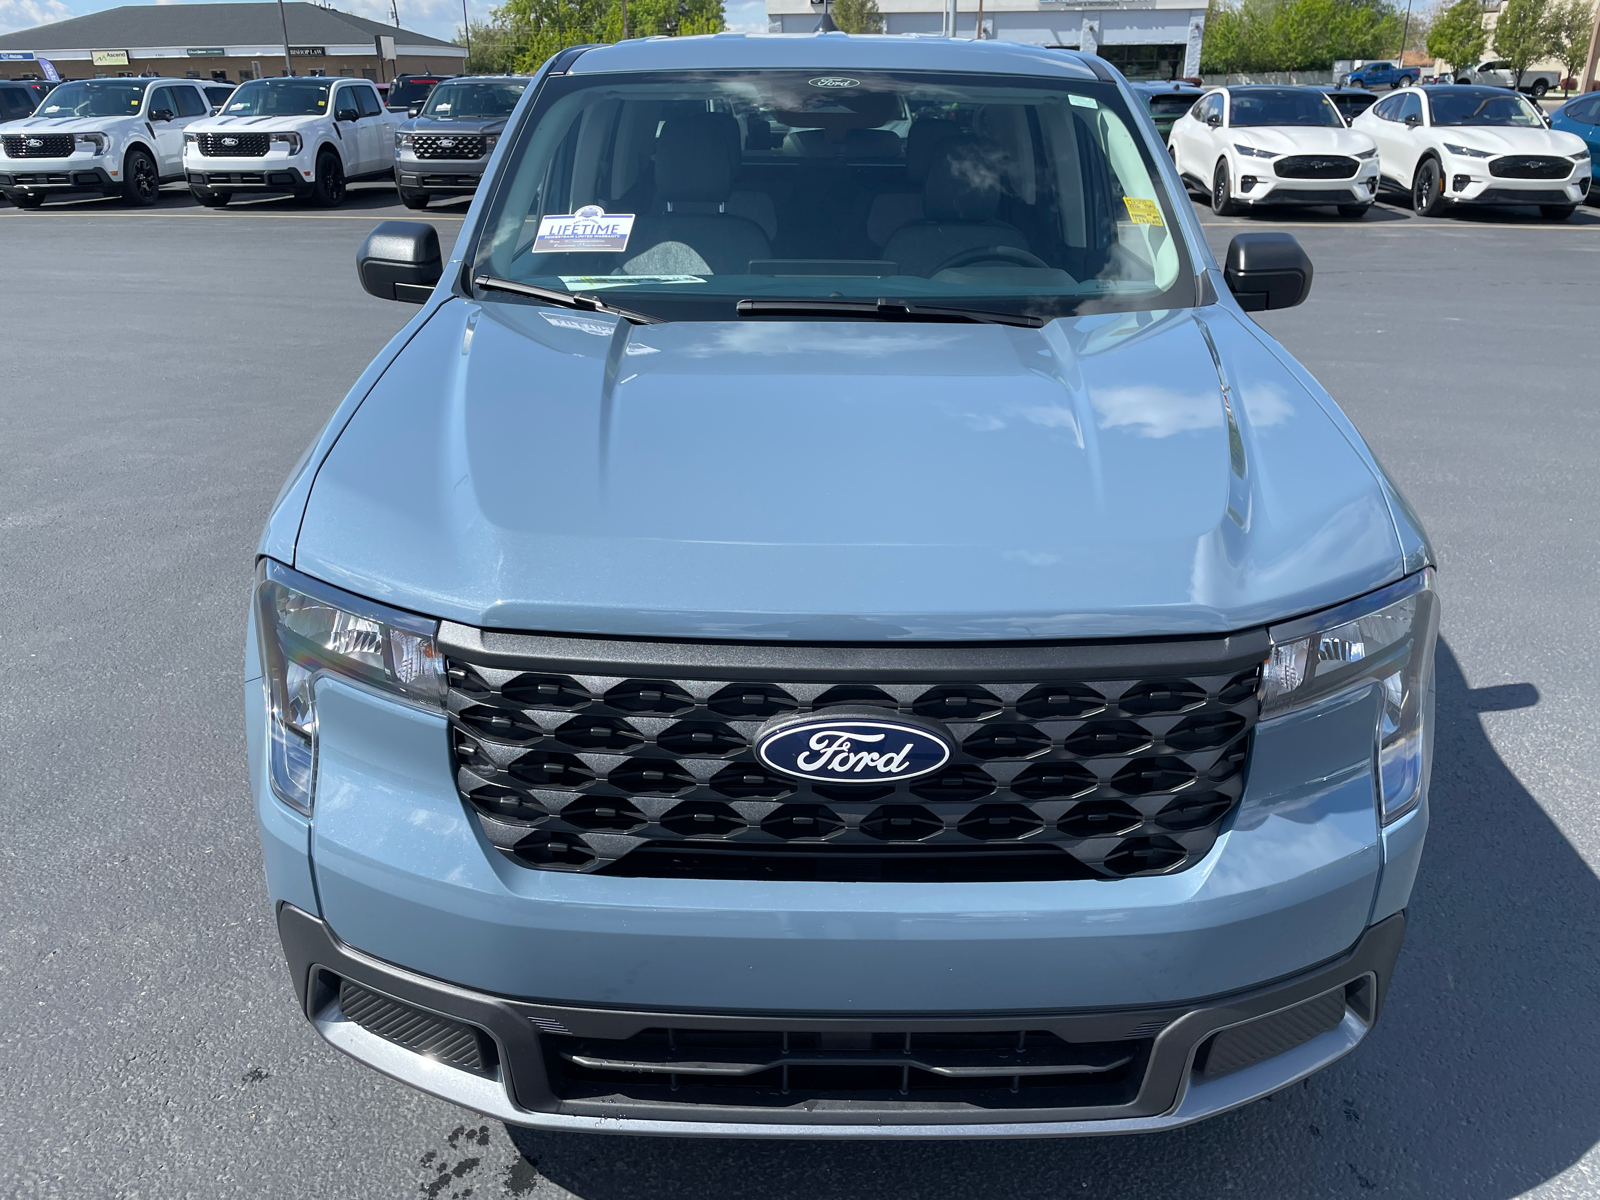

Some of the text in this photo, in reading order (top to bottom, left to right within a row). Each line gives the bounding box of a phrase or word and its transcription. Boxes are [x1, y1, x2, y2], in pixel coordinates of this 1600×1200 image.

[817, 78, 851, 87] Ford
[549, 224, 620, 235] LIFETIME
[797, 730, 914, 773] Ford
